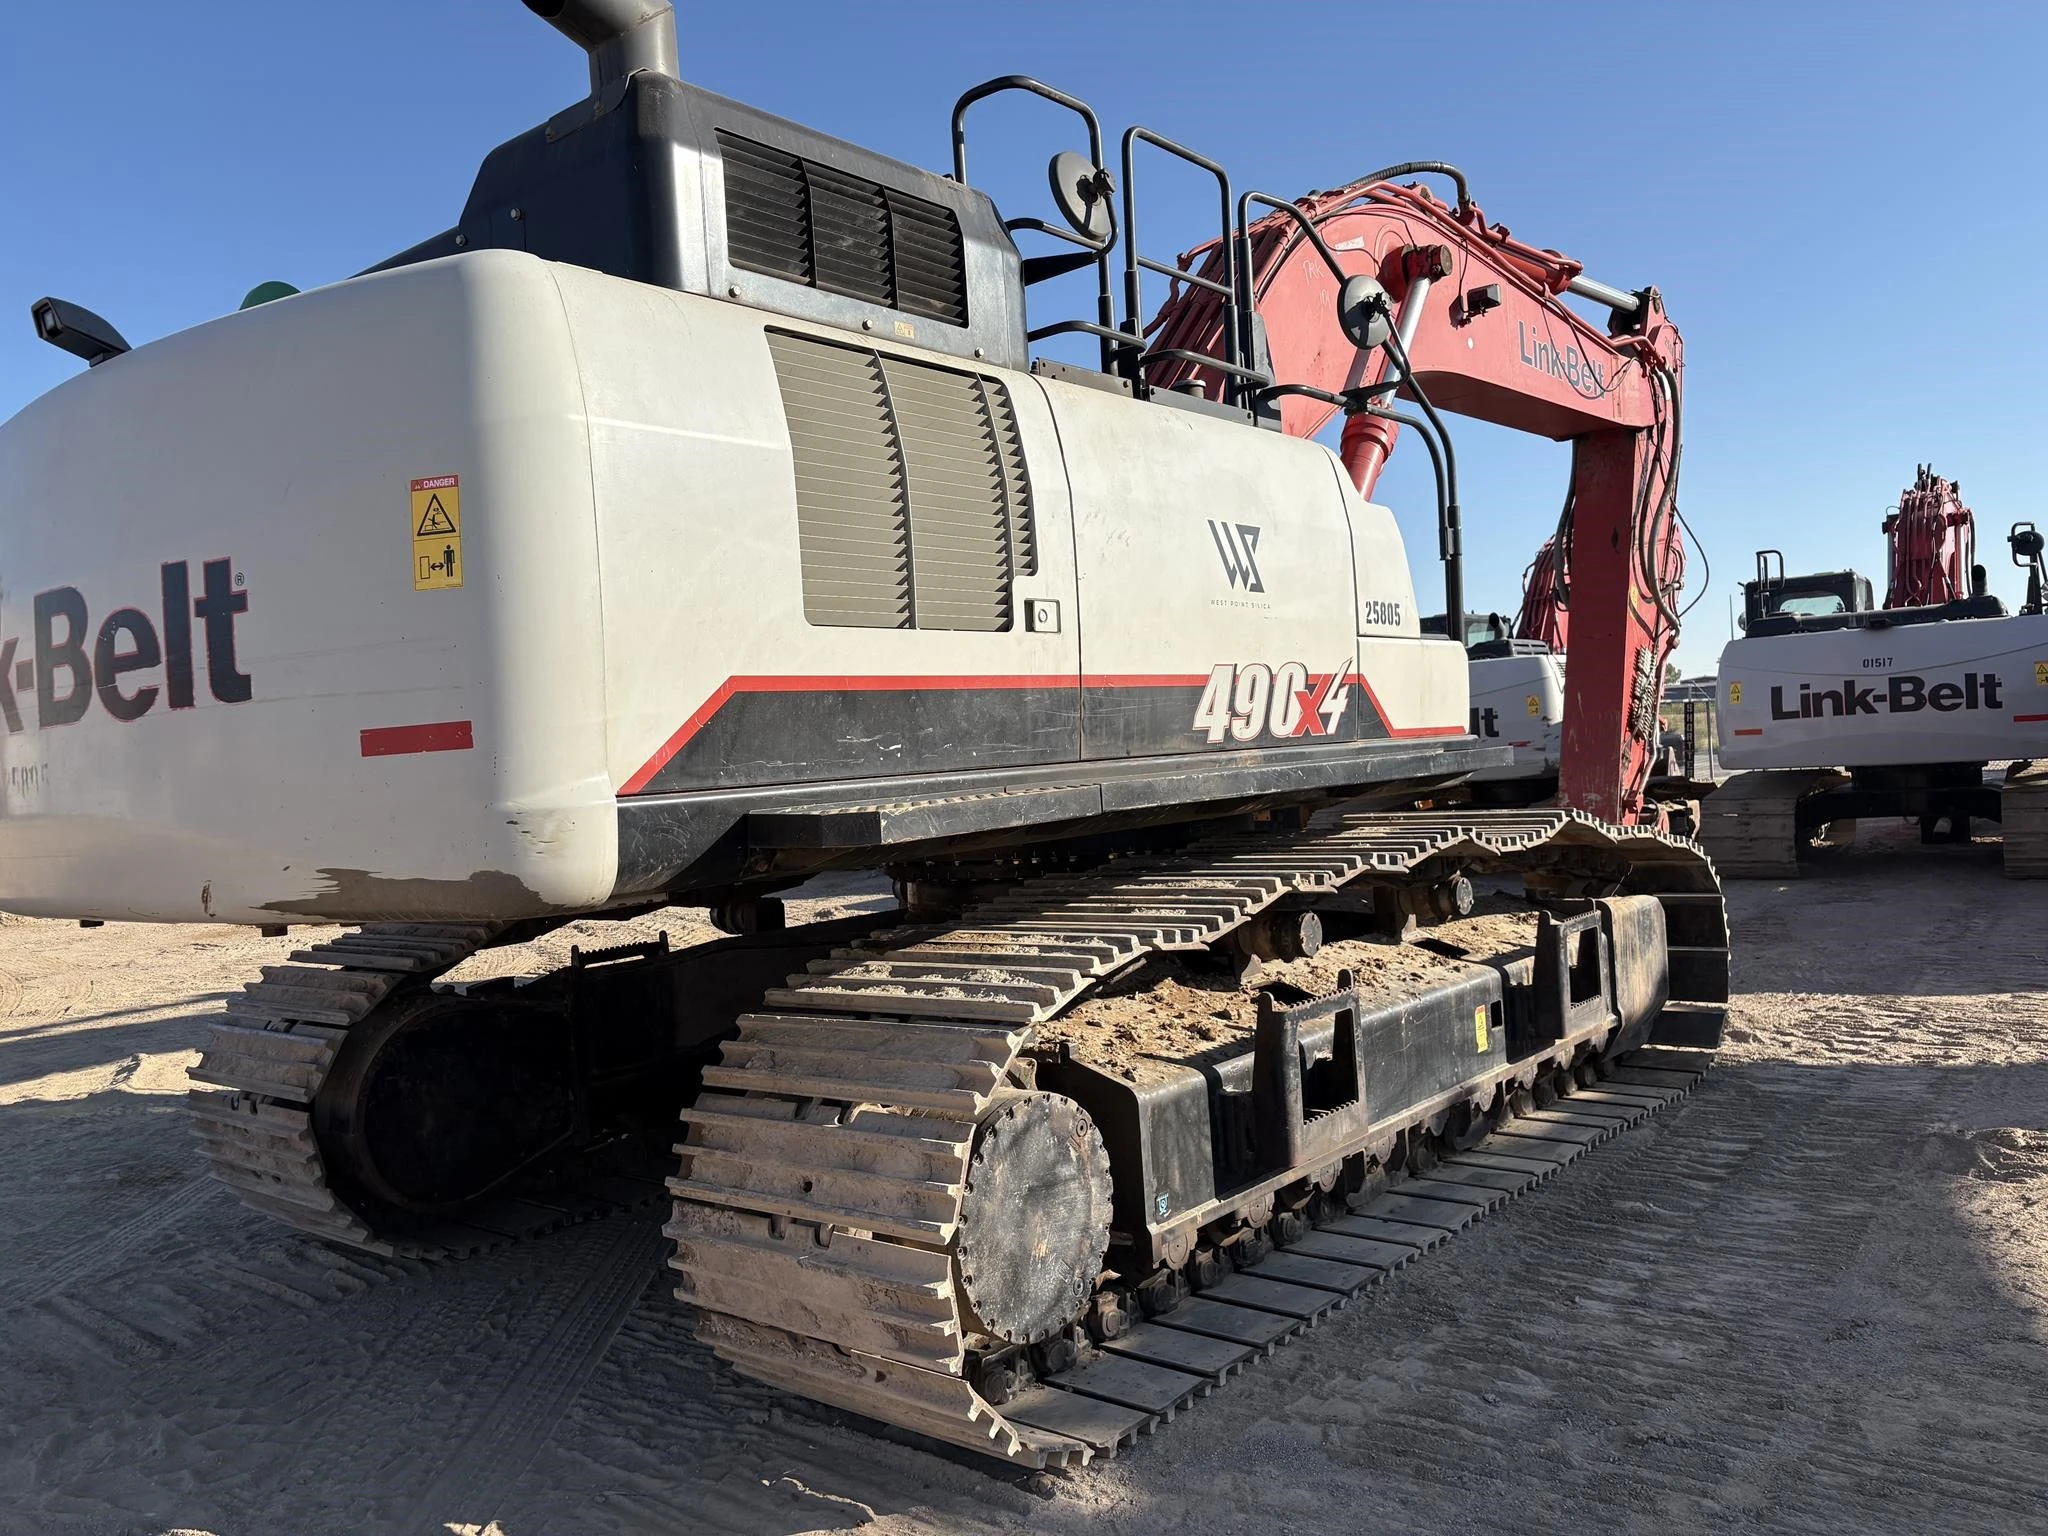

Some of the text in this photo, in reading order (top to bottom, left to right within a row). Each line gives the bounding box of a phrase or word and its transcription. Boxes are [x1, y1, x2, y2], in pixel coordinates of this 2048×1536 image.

[1519, 320, 1605, 399] Link-Belt
[423, 477, 455, 489] DANGER
[1210, 599, 1228, 607] WEST
[1365, 600, 1401, 626] 25805
[1862, 657, 1893, 668] 01517
[1770, 673, 2003, 721] Link-Belt
